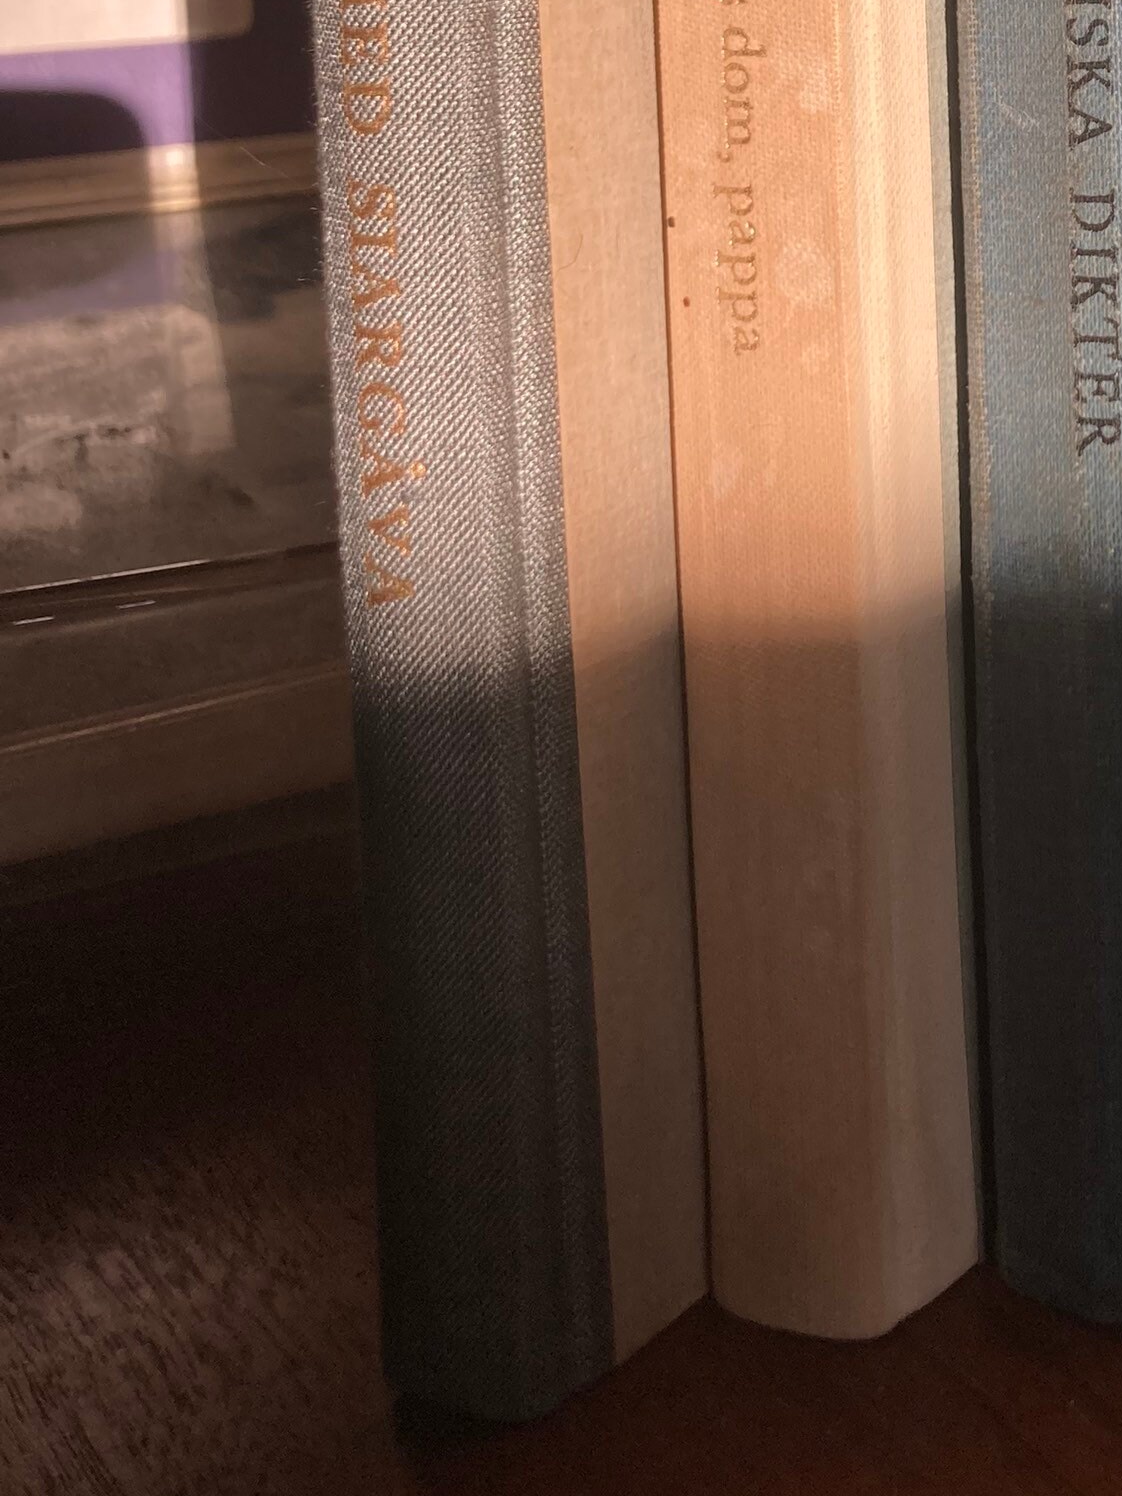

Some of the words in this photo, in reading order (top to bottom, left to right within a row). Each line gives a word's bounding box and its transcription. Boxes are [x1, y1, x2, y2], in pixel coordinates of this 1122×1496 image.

[717, 26, 767, 164] dom,
[713, 182, 761, 354] pappa
[345, 180, 428, 606] SIARGÅVA
